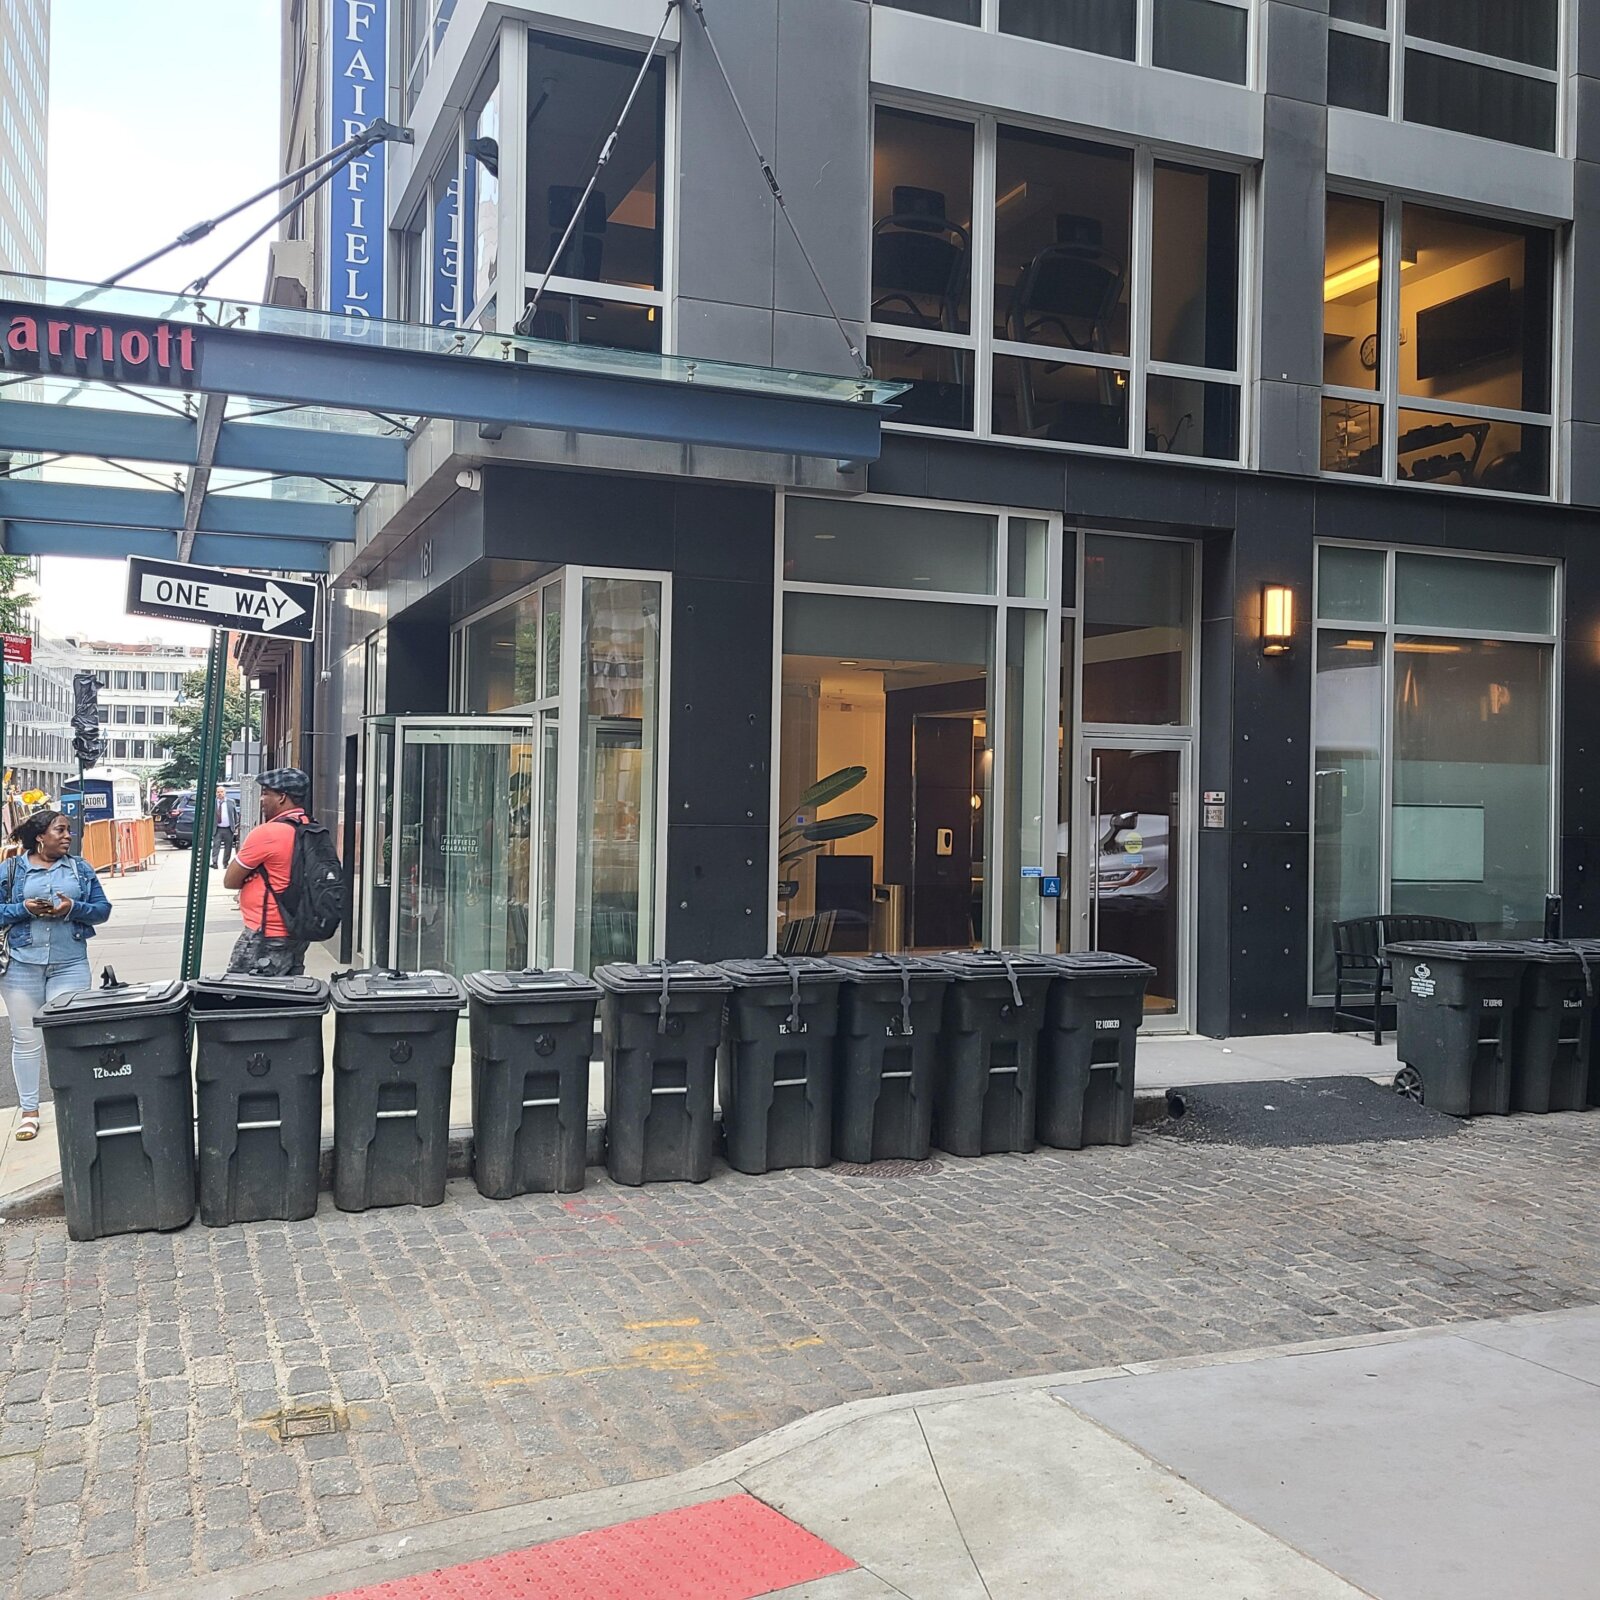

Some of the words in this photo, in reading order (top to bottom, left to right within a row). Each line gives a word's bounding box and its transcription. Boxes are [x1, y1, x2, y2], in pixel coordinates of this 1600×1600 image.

[0, 315, 197, 371] arriott
[420, 539, 432, 579] 161
[156, 580, 210, 608] ONE
[235, 591, 288, 618] WAY
[85, 796, 105, 806] ATORY
[67, 802, 76, 815] P
[443, 838, 477, 846] FAIRFIELD
[440, 845, 479, 853] GUARANTEE
